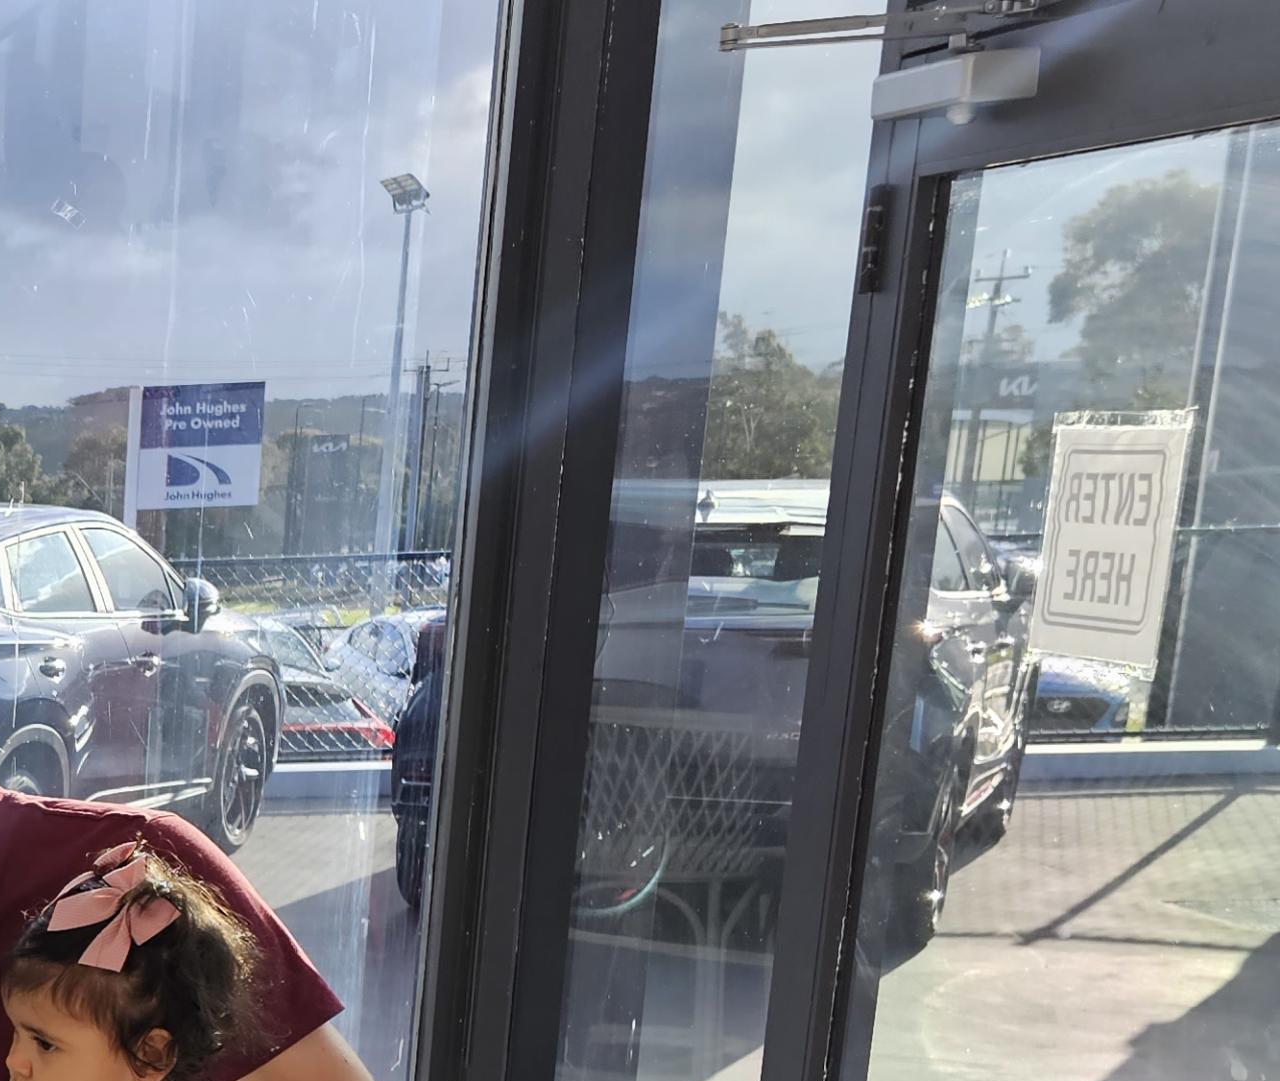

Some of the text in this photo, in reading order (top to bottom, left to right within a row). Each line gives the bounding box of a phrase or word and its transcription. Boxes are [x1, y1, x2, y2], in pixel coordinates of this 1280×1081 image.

[160, 400, 247, 418] John Hughes
[165, 415, 240, 430] Pre Owned
[164, 490, 232, 502] John Hughes
